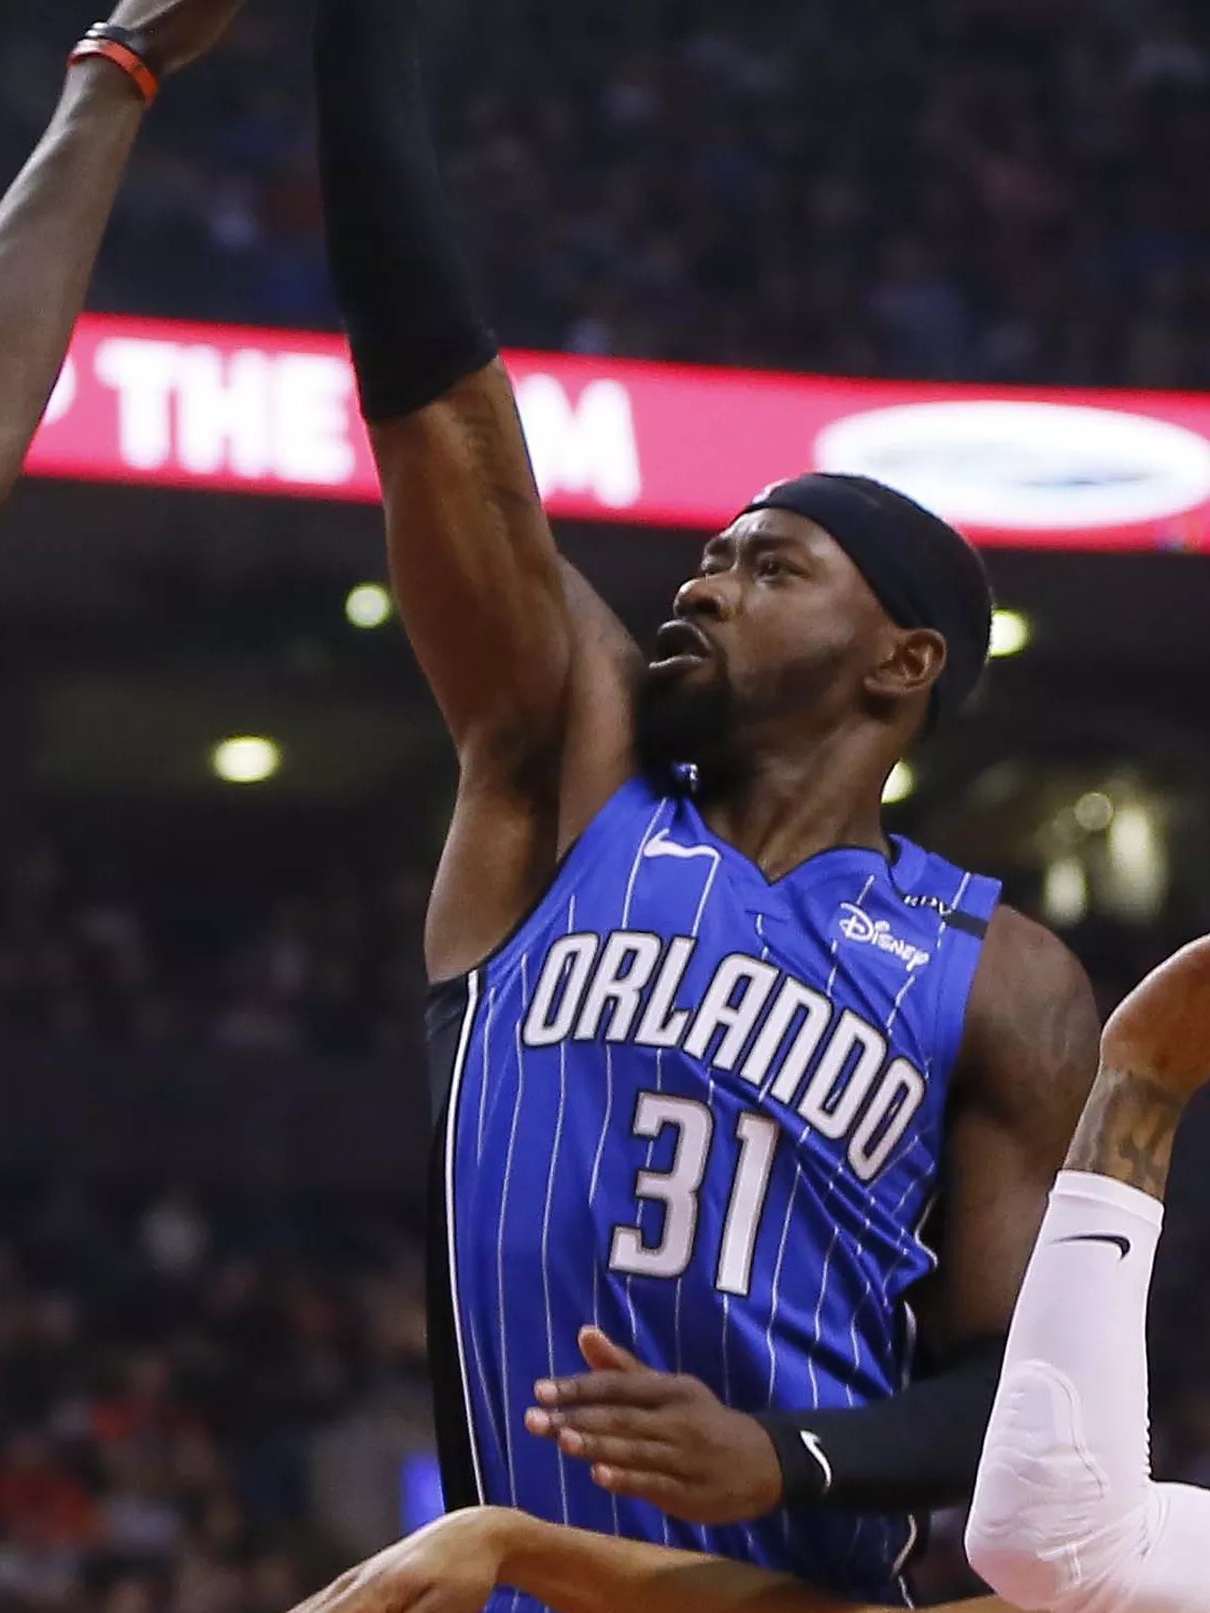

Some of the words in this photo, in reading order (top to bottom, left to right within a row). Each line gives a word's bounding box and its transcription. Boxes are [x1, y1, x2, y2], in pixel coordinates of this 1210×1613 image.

[95, 337, 357, 484] THE
[839, 902, 930, 972] Disney
[522, 930, 928, 1182] ORLANDO
[608, 1092, 781, 1296] 31
